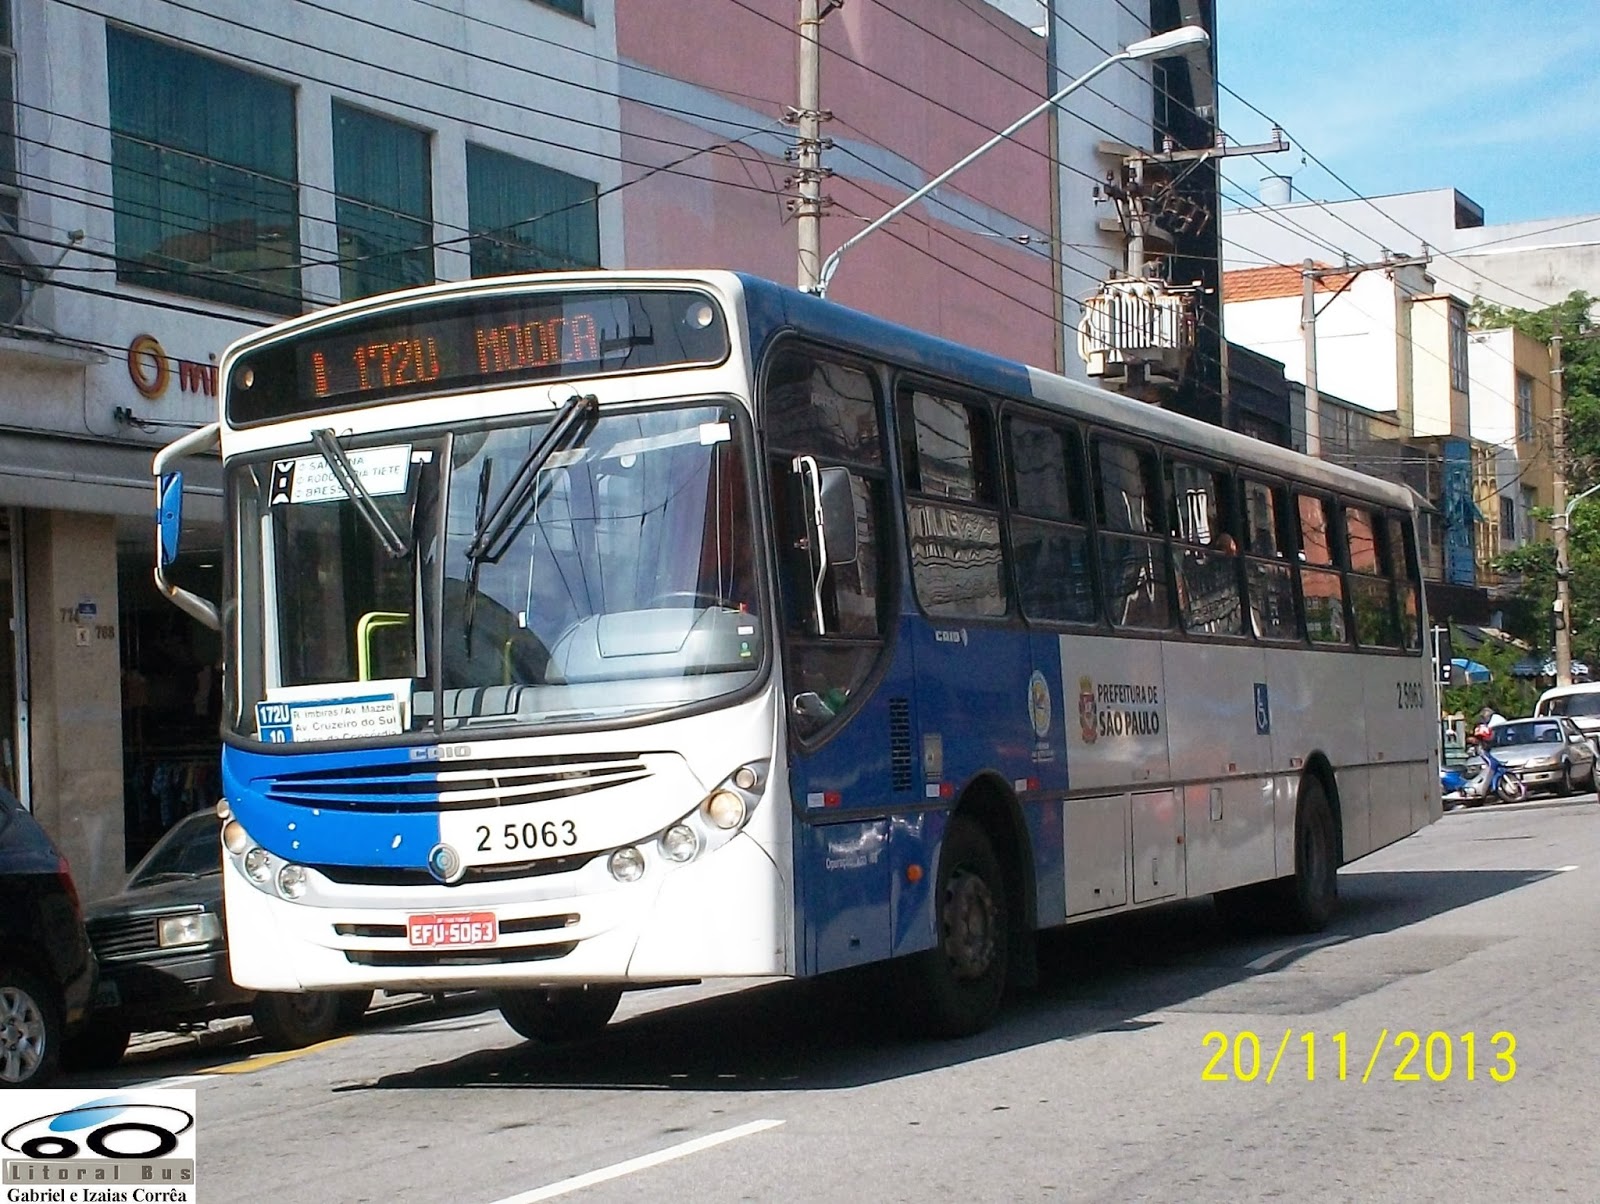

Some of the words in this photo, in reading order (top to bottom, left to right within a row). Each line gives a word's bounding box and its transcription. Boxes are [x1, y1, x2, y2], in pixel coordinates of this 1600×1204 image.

[353, 338, 439, 389] 172U
[477, 315, 598, 373] MOOCA
[1097, 684, 1146, 703] PREFEITURA
[1147, 685, 1158, 704] DE
[260, 704, 290, 724] 172U
[313, 720, 358, 731] Cruzeiro
[361, 718, 375, 727] do
[379, 715, 396, 725] Sul
[1099, 705, 1123, 736] SÃO
[1125, 711, 1159, 736] PAULO
